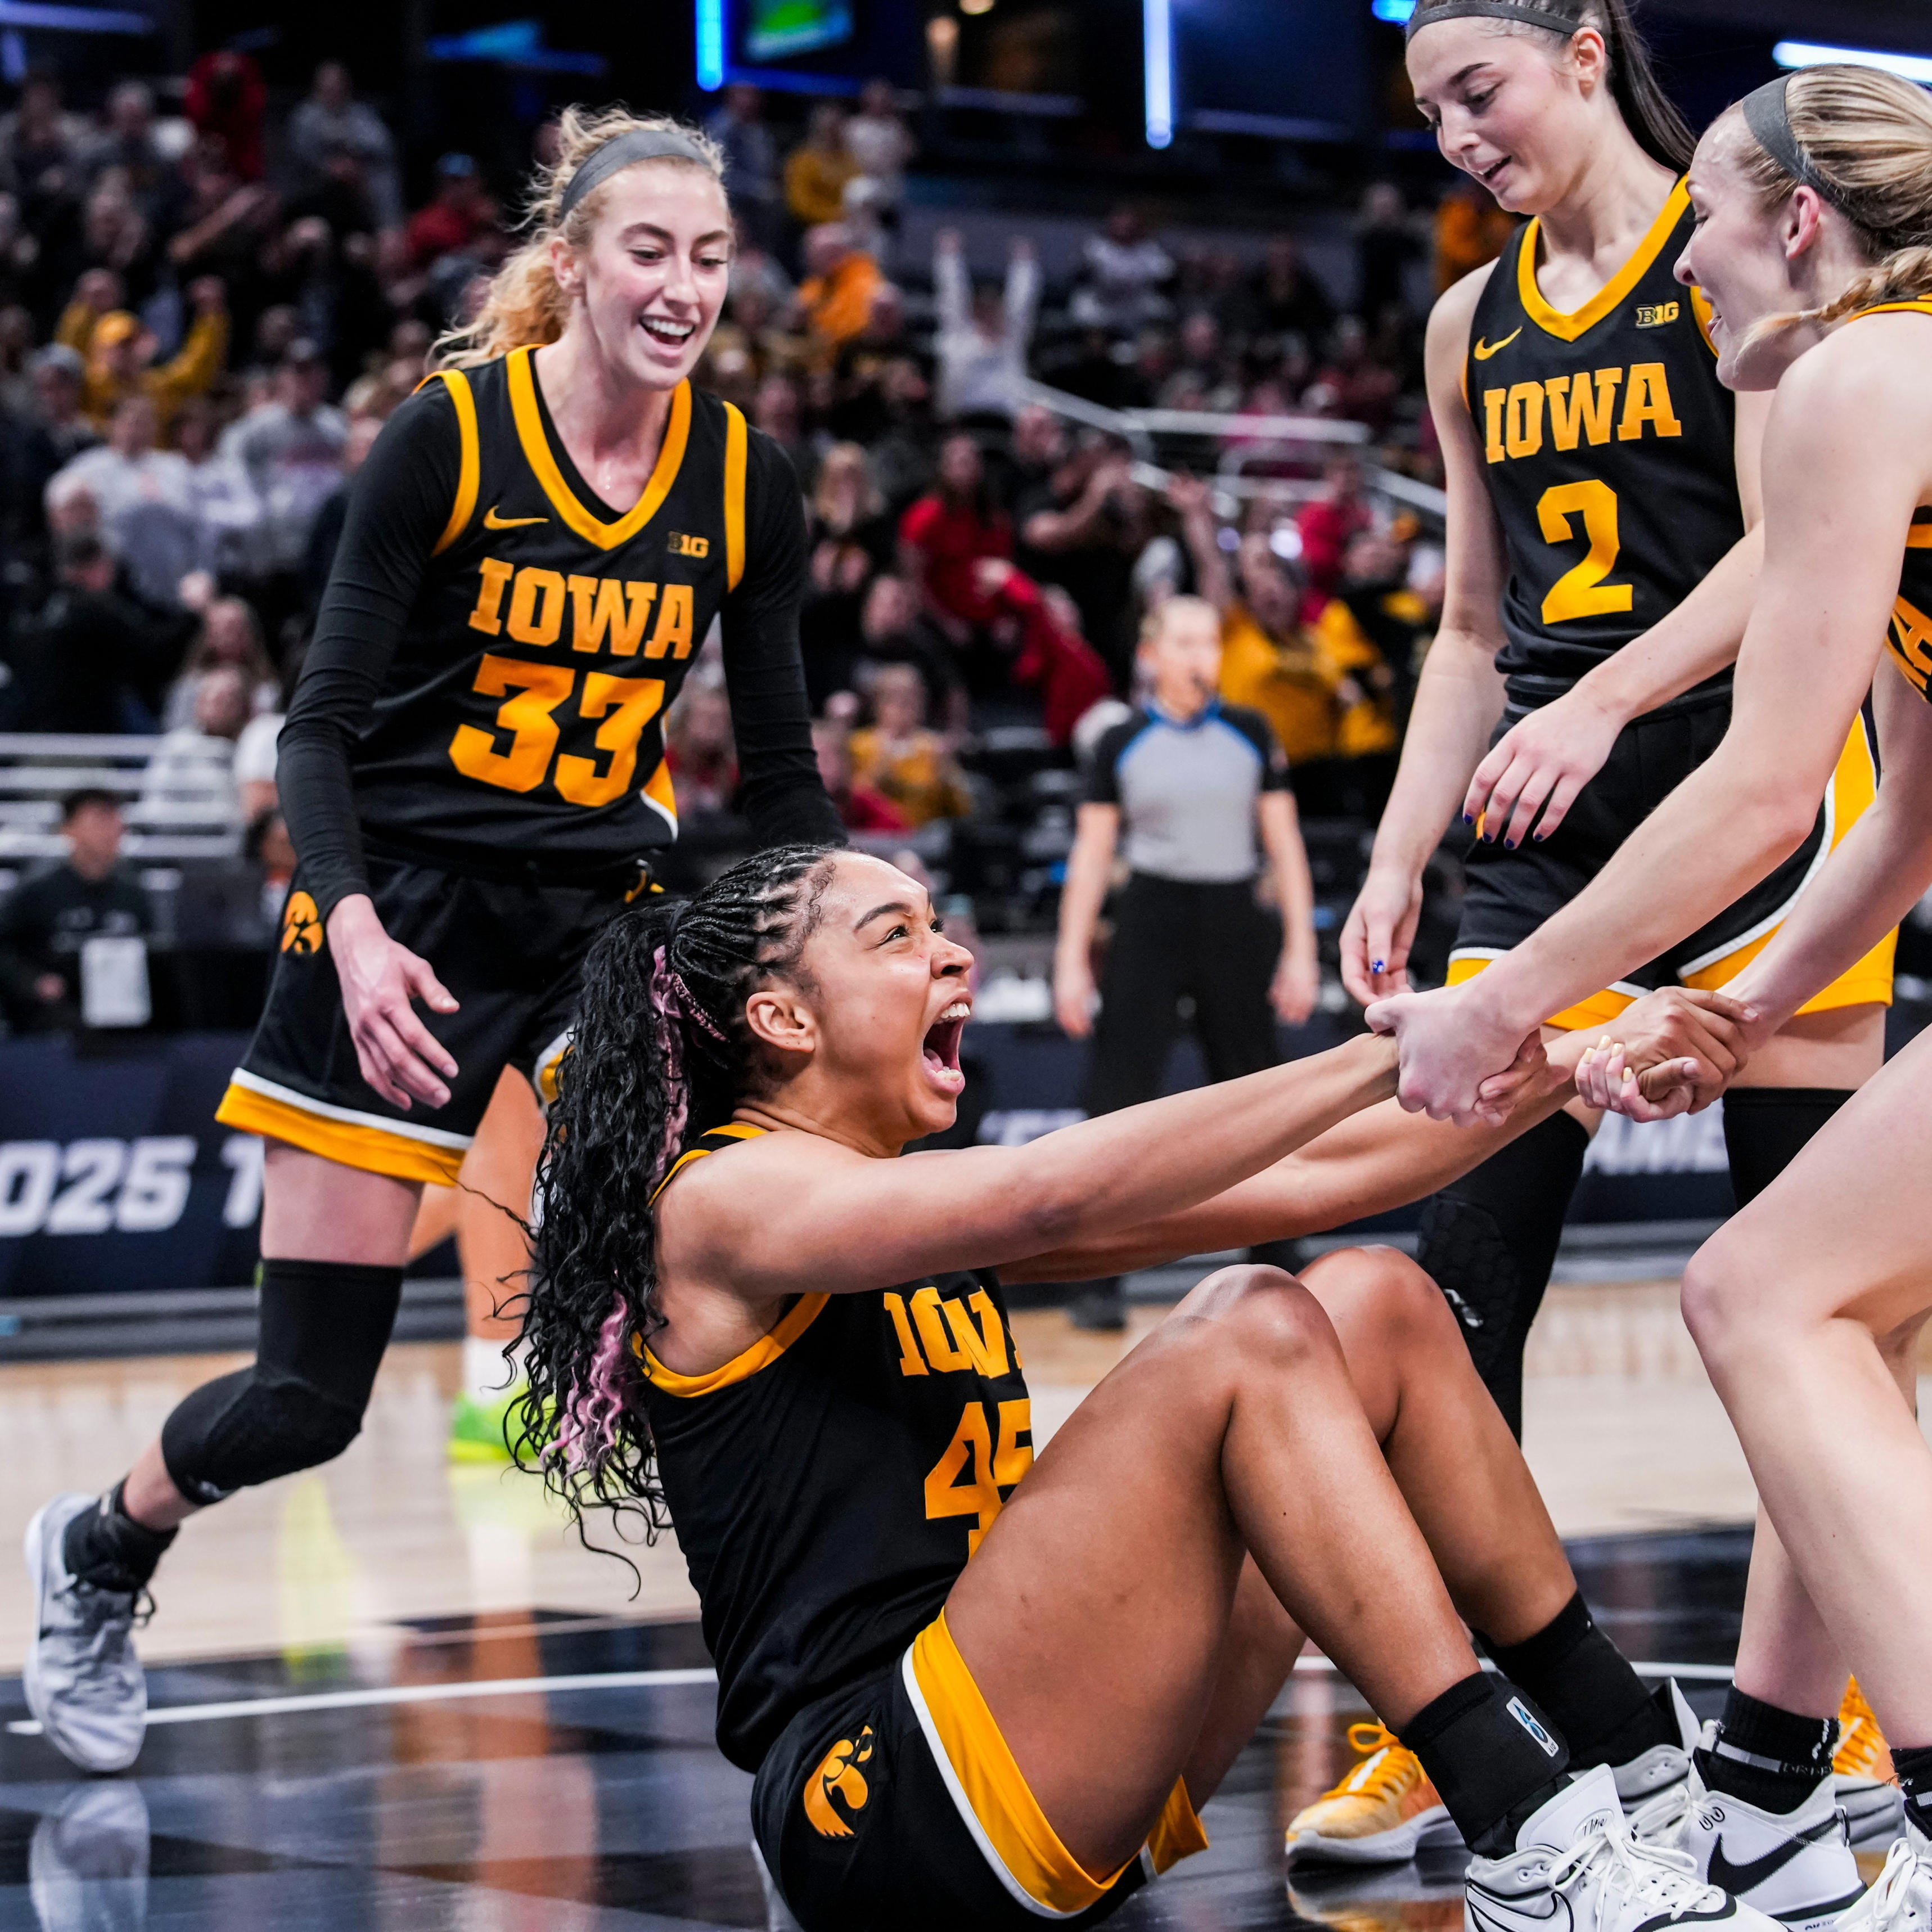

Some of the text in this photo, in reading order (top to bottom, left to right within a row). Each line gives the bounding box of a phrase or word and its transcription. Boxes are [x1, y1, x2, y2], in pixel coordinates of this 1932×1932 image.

[1484, 362, 1682, 464] IOWA
[468, 556, 694, 659] IOWA
[1537, 480, 1633, 625] 2
[449, 654, 665, 808] 33
[884, 1286, 1023, 1379] IOW
[925, 1398, 1034, 1561] 45
